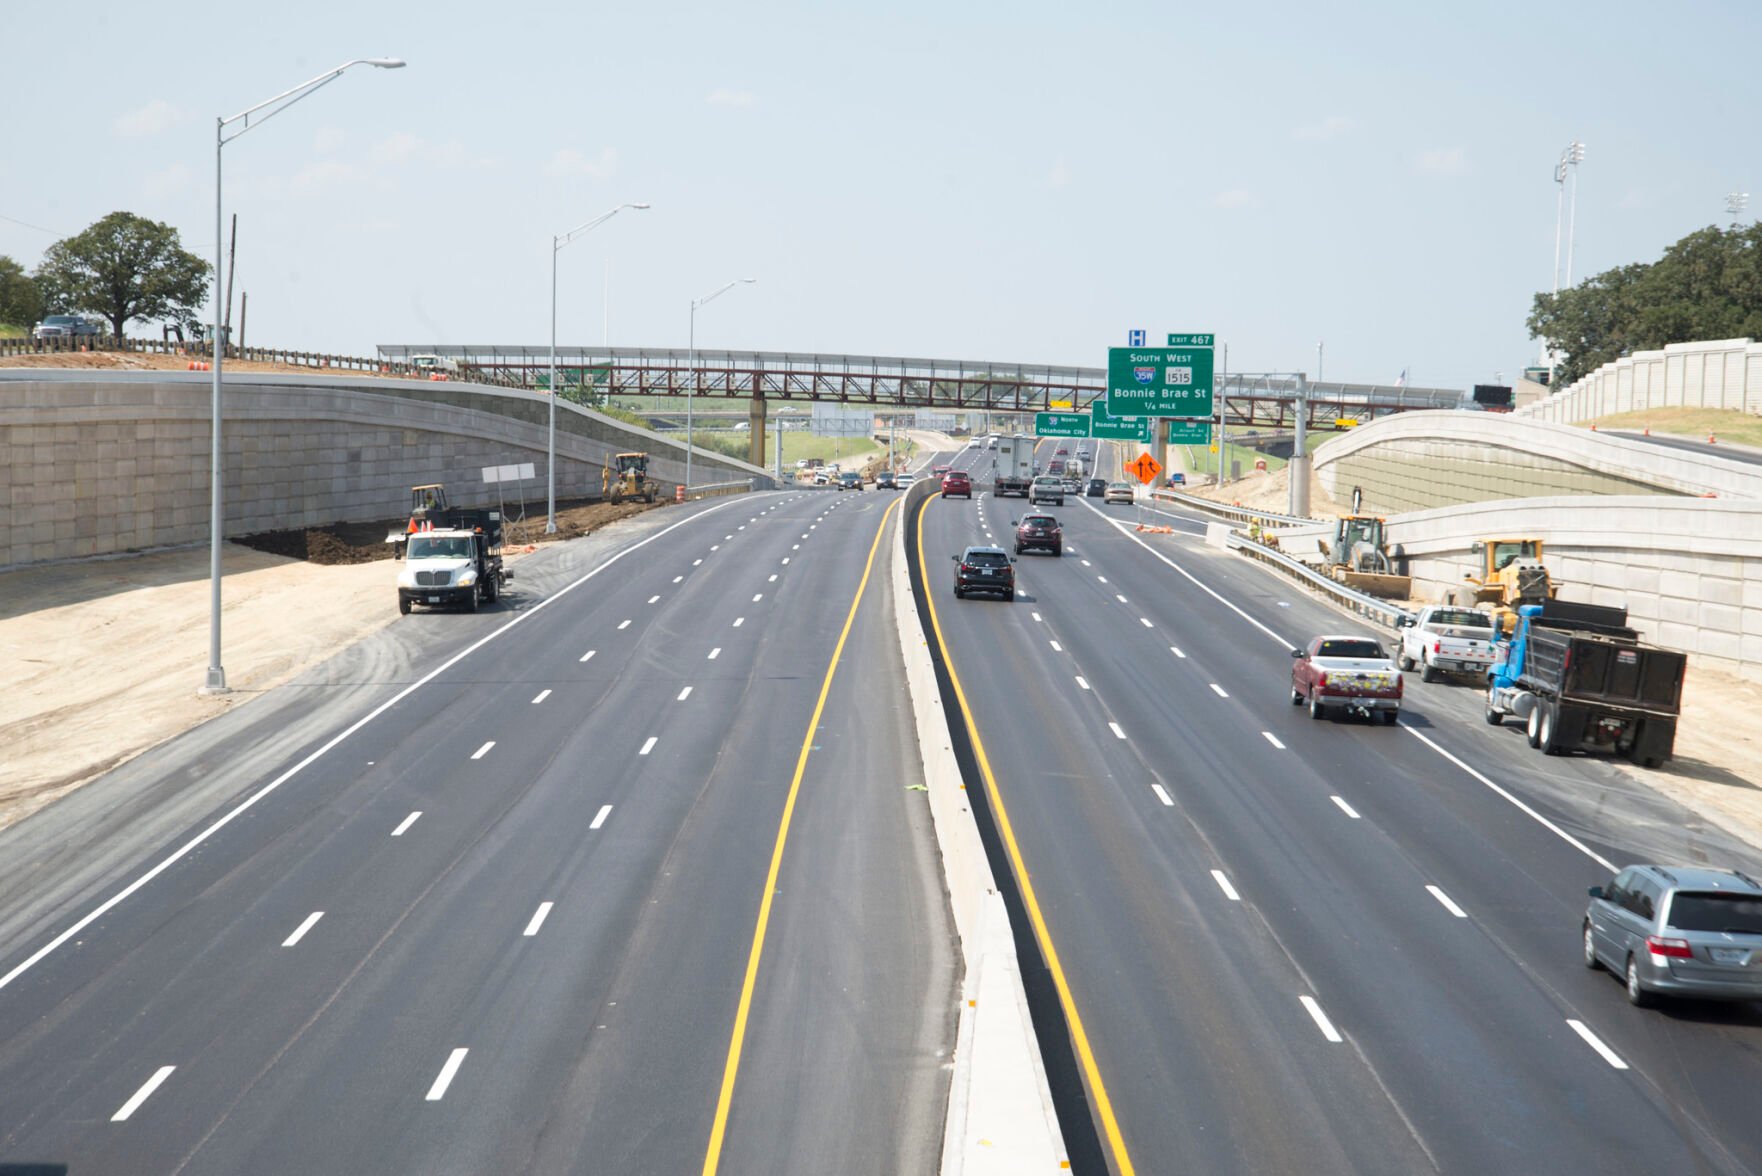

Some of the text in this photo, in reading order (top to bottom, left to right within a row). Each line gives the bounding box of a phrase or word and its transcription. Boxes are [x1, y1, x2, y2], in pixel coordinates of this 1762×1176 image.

[1131, 330, 1144, 346] H
[1190, 335, 1210, 344] 467
[1129, 353, 1192, 362] SOUTH WEST
[1167, 373, 1190, 383] 1515
[1114, 388, 1206, 398] Bonnie Brae St
[1159, 402, 1177, 410] MILE
[1039, 427, 1071, 435] Oklahoma
